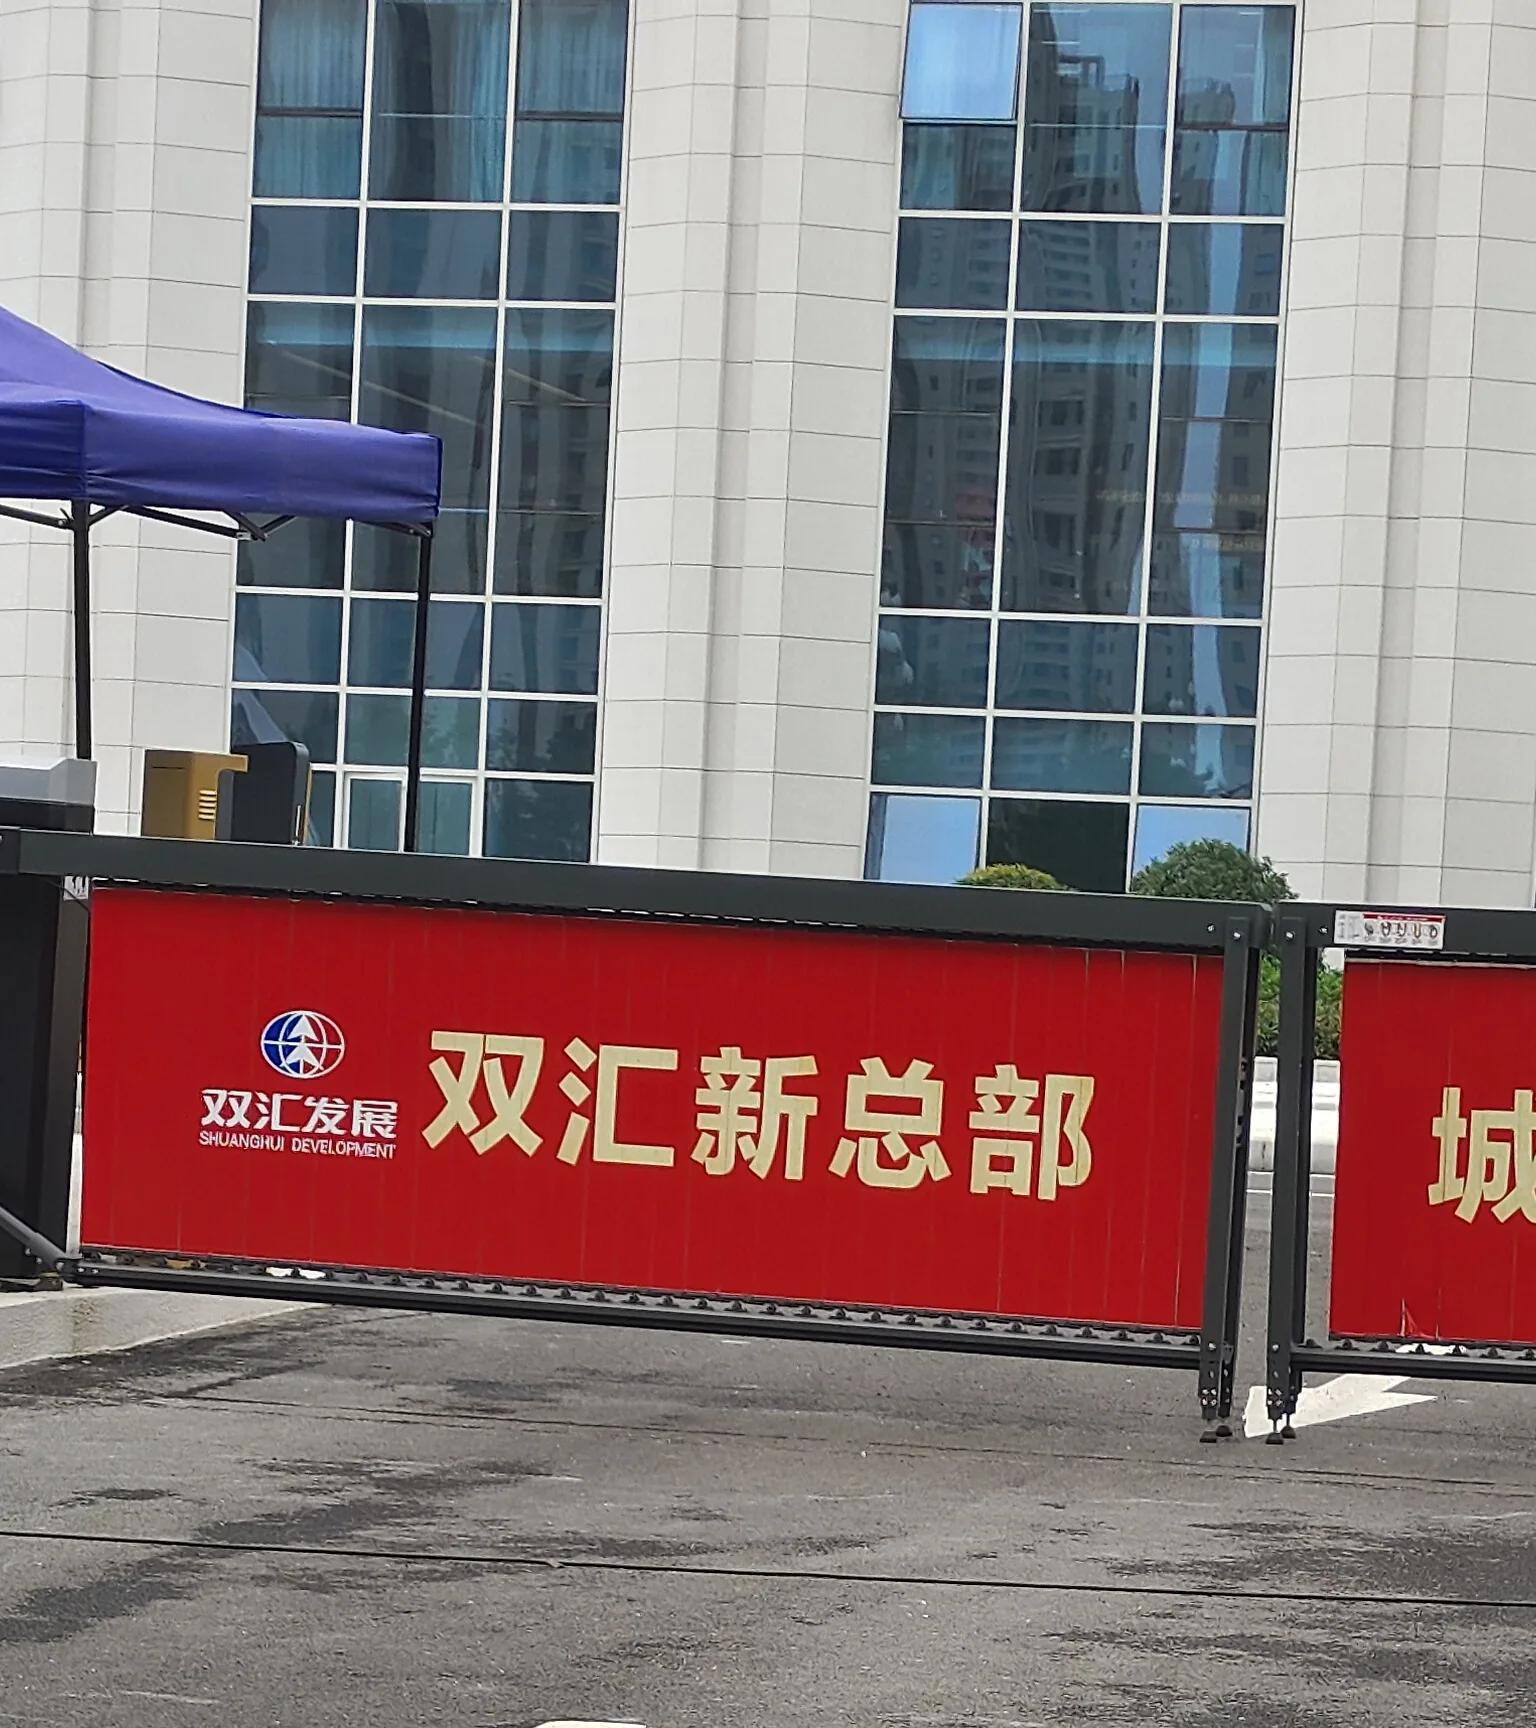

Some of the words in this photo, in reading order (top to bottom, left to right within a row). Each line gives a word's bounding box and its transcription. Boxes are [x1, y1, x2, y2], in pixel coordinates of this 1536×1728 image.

[200, 1088, 399, 1139] 双汇发展
[421, 1029, 1095, 1201] 双汇新总部
[198, 1130, 285, 1152] SHUANGHUI
[291, 1137, 396, 1159] DEVELOPMENT
